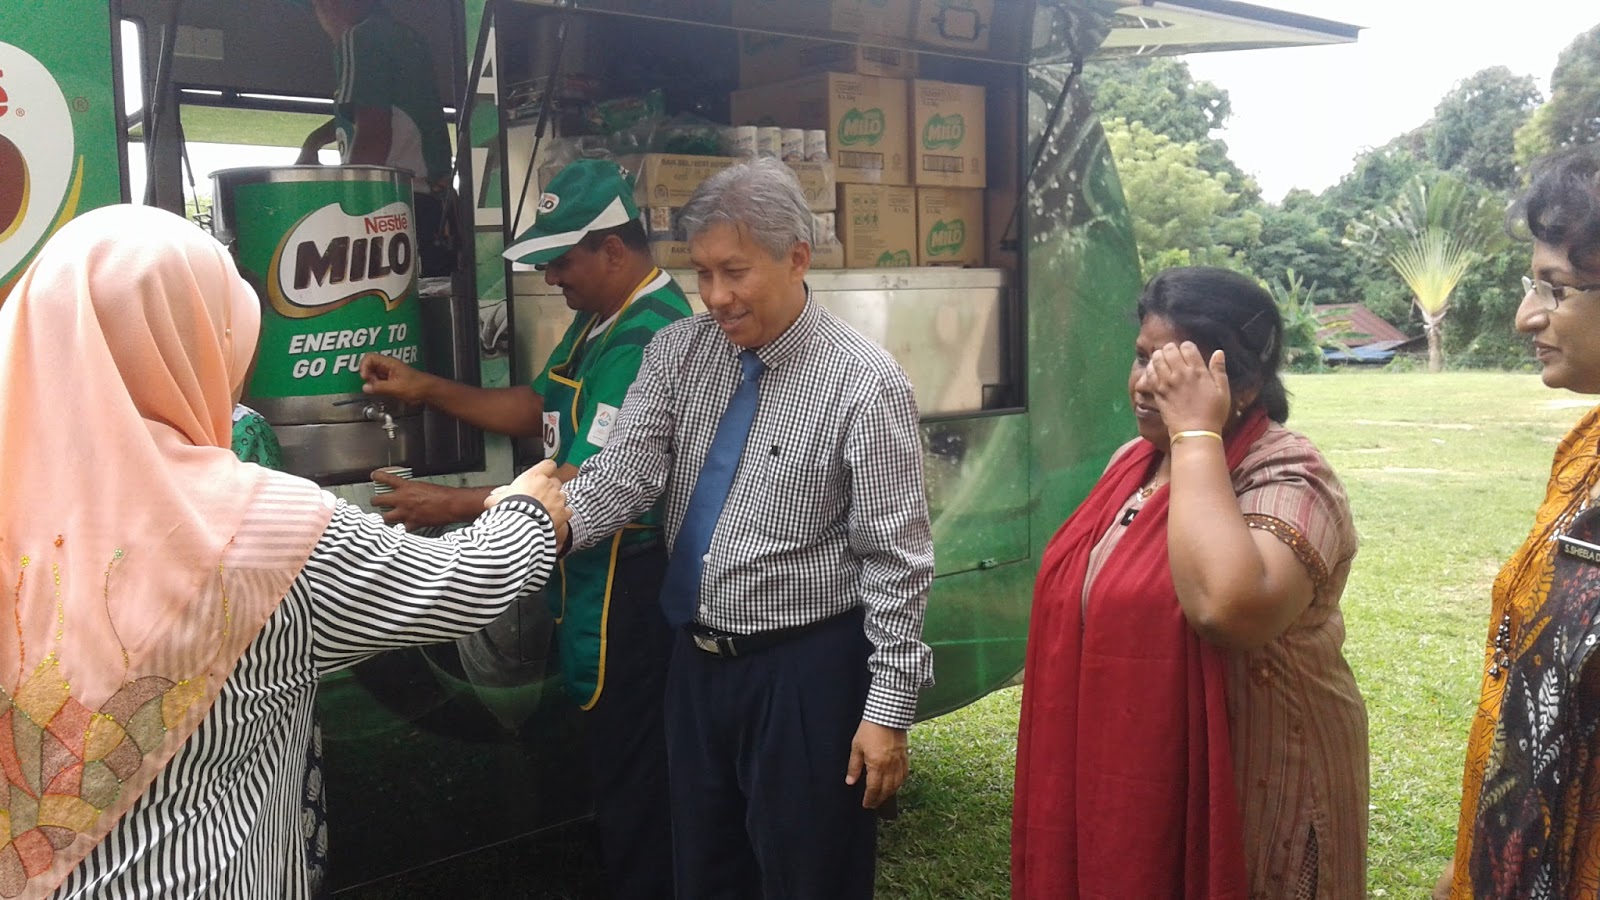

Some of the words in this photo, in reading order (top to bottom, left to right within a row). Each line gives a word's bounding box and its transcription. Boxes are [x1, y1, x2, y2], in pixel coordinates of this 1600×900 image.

[844, 118, 882, 136] MILO
[928, 124, 962, 141] MILO
[364, 213, 408, 234] Nestlé
[293, 232, 410, 291] MILO
[288, 326, 382, 355] ENERGY
[388, 322, 407, 343] TO
[292, 357, 327, 379] GO
[332, 345, 418, 375] FUHER
